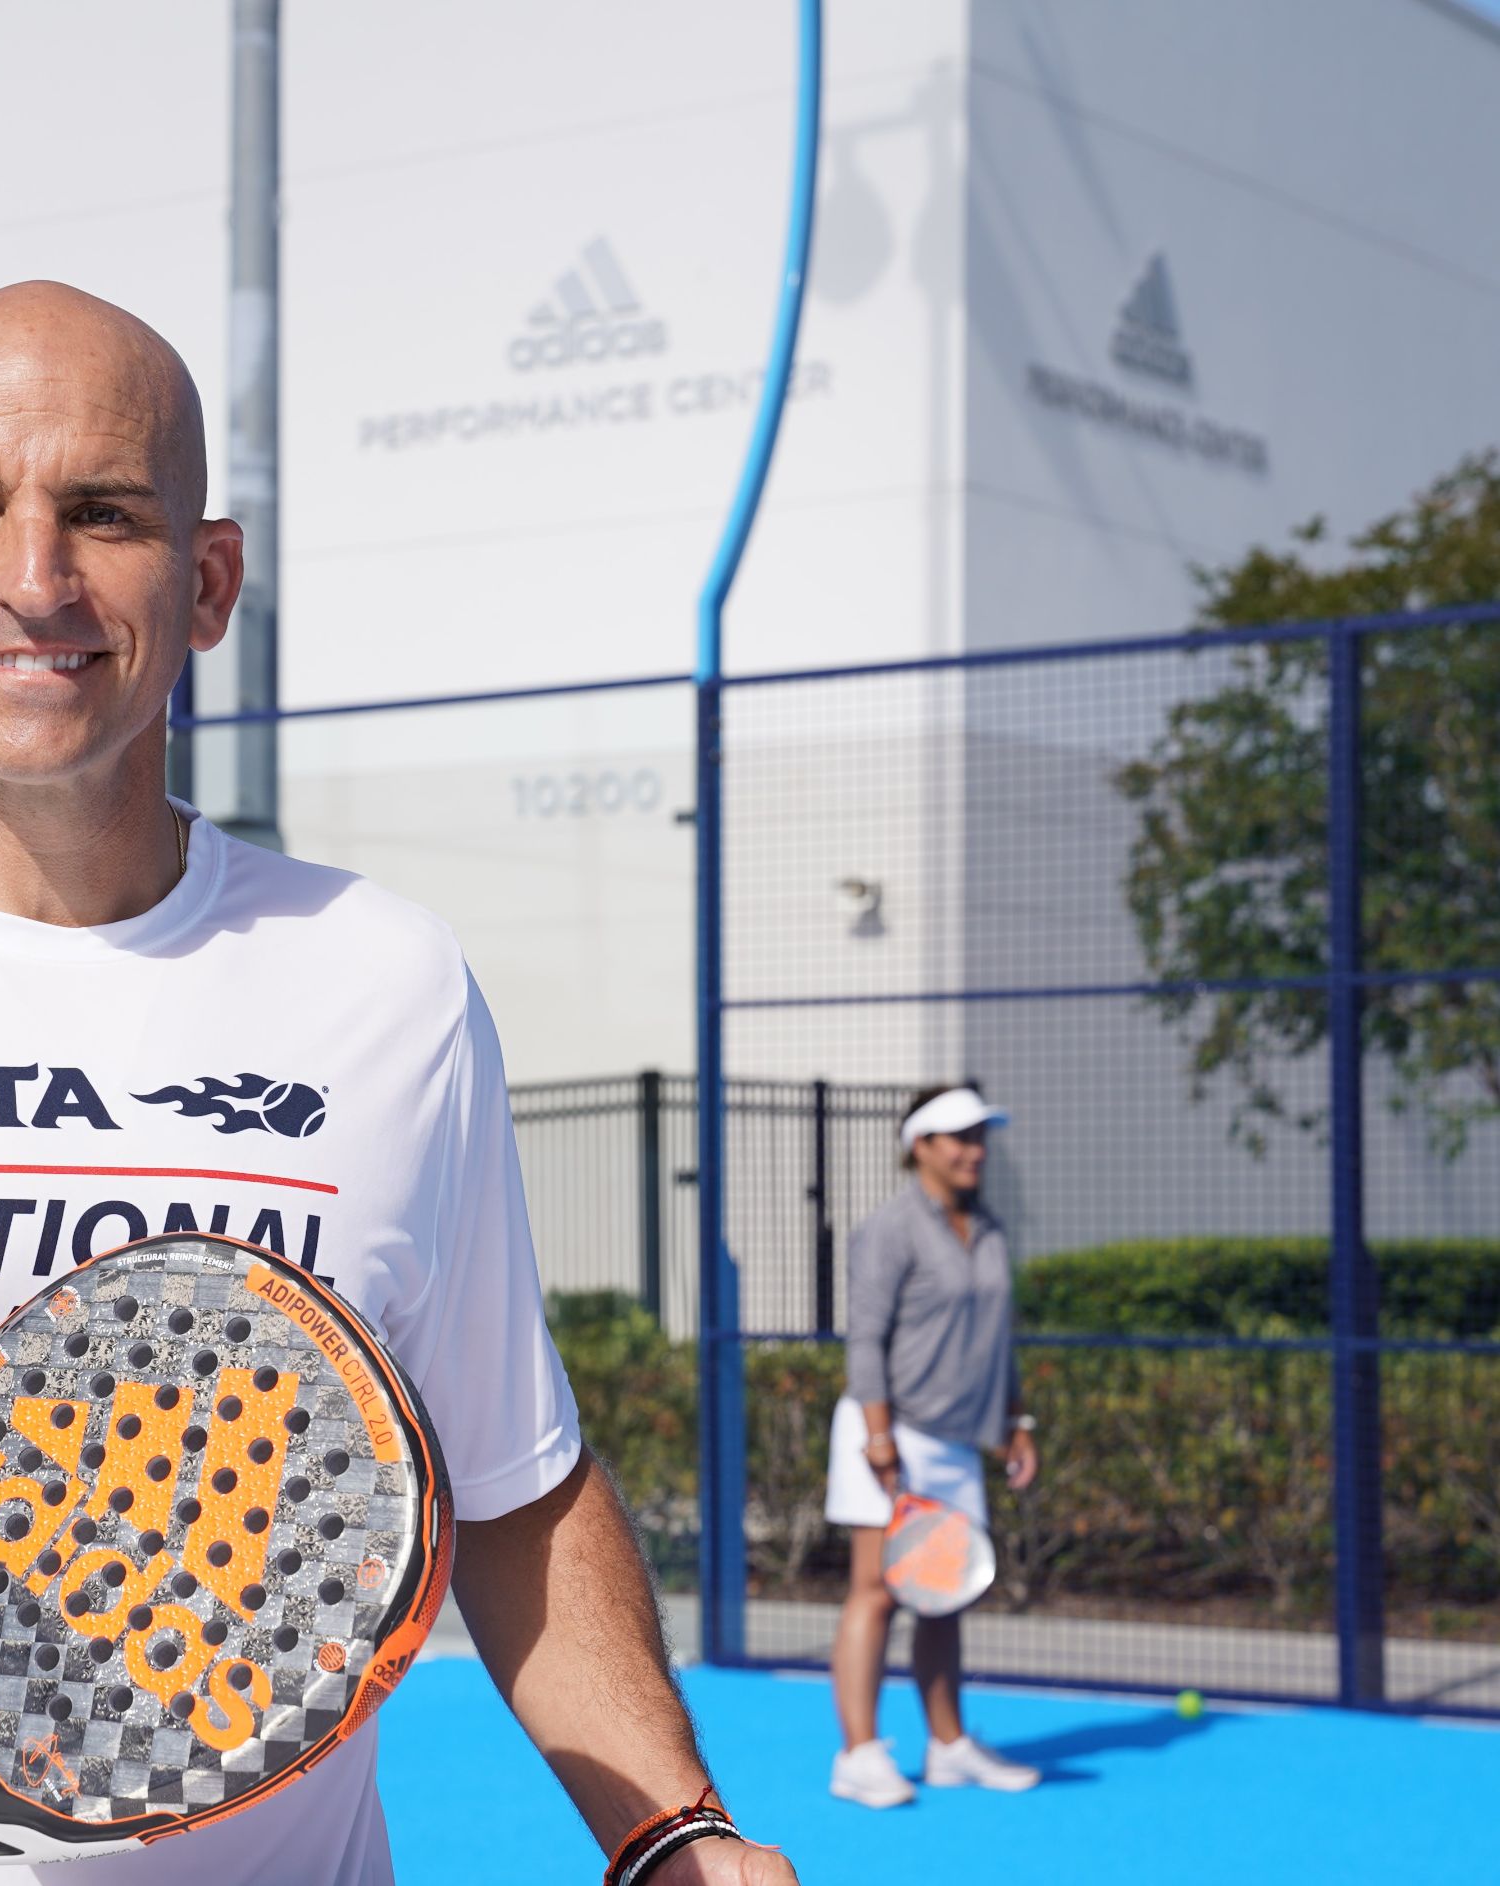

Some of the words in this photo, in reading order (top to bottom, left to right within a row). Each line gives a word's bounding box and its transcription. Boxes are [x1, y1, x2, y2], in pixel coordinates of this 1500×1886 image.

[507, 316, 668, 372] adidas
[358, 380, 653, 452] PERFORMANCE
[509, 769, 663, 818] 10200
[116, 1252, 168, 1267] STRUCTURAL
[169, 1252, 235, 1271] REINFORCEMENT
[259, 1278, 349, 1361] ADIPOWER
[342, 1359, 376, 1414] CTRL
[368, 1413, 393, 1446] 2.0
